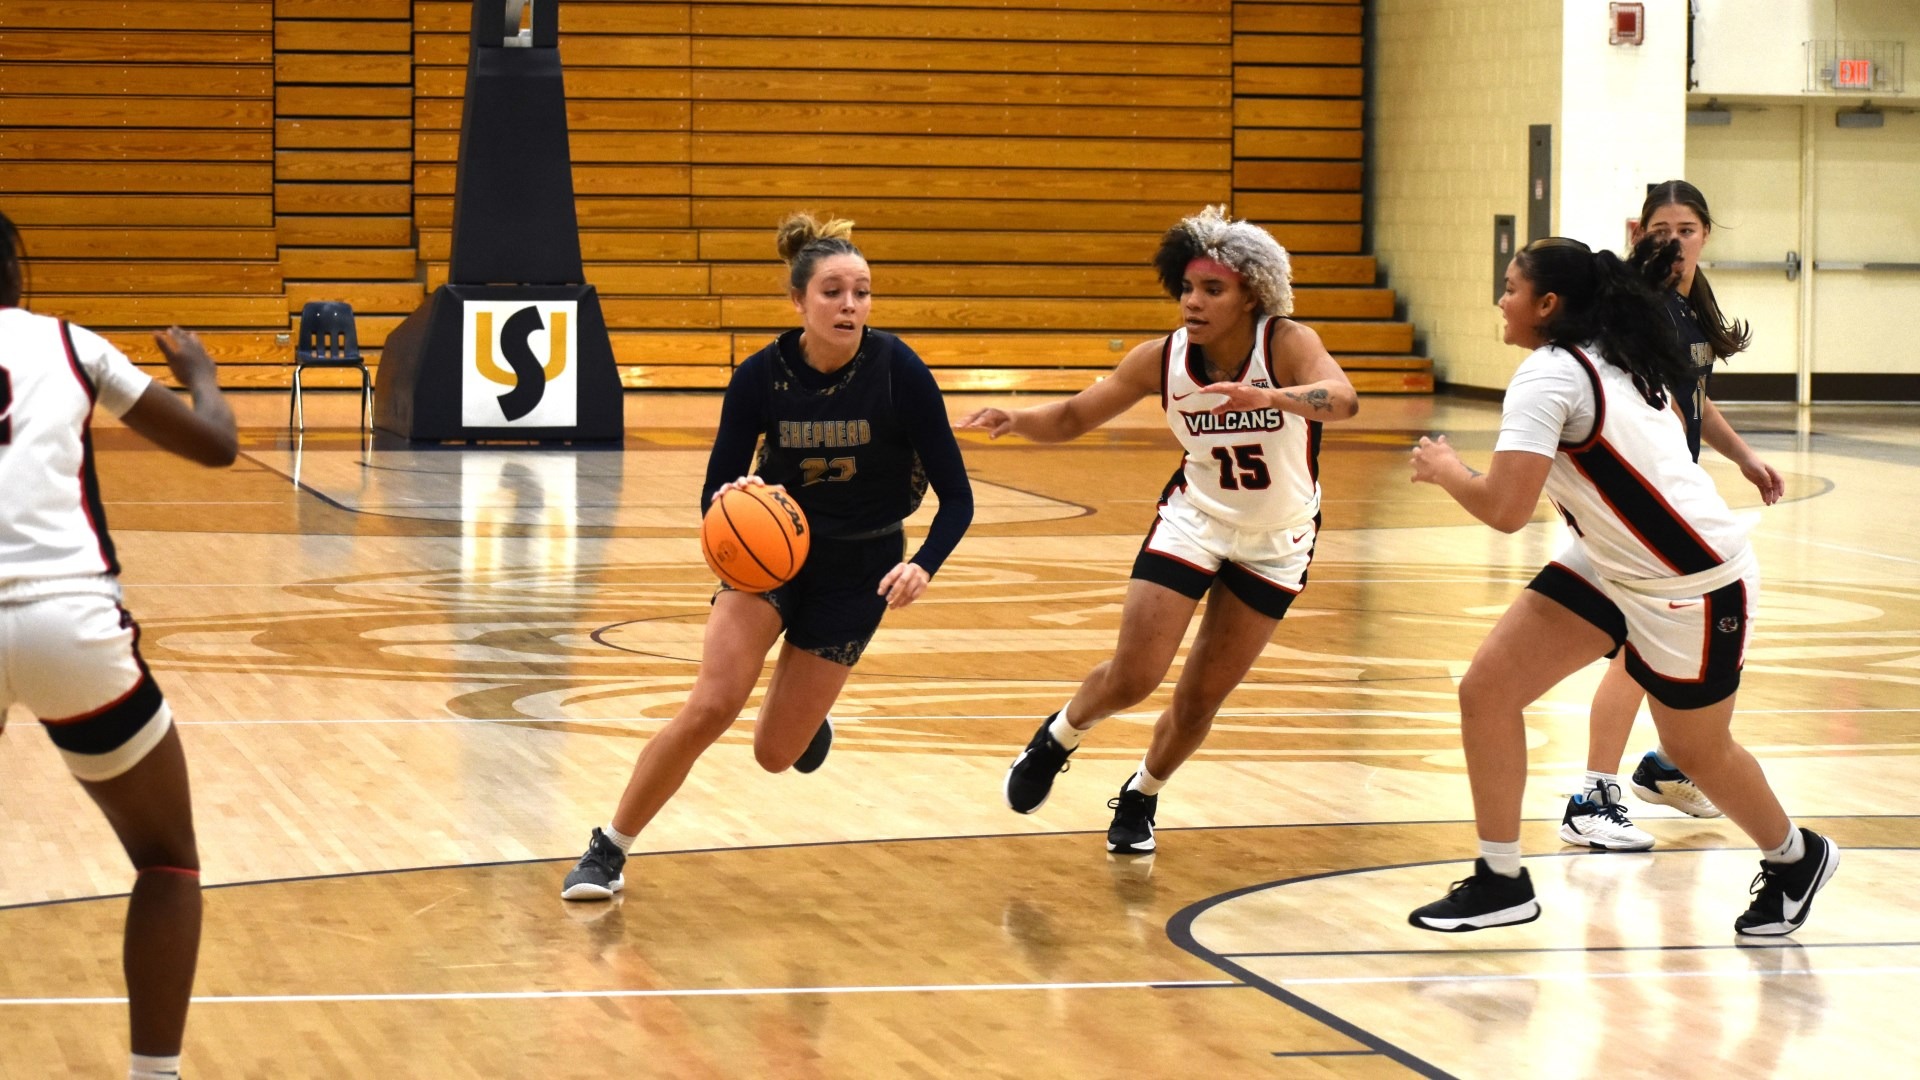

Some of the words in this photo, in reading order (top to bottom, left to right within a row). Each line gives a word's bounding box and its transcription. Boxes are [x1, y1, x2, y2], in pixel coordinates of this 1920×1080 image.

[1839, 60, 1869, 85] EXIT
[779, 419, 871, 448] SHEPHERD
[1182, 408, 1282, 434] VULCANS
[1211, 444, 1271, 490] 15
[768, 491, 805, 537] NCAA
